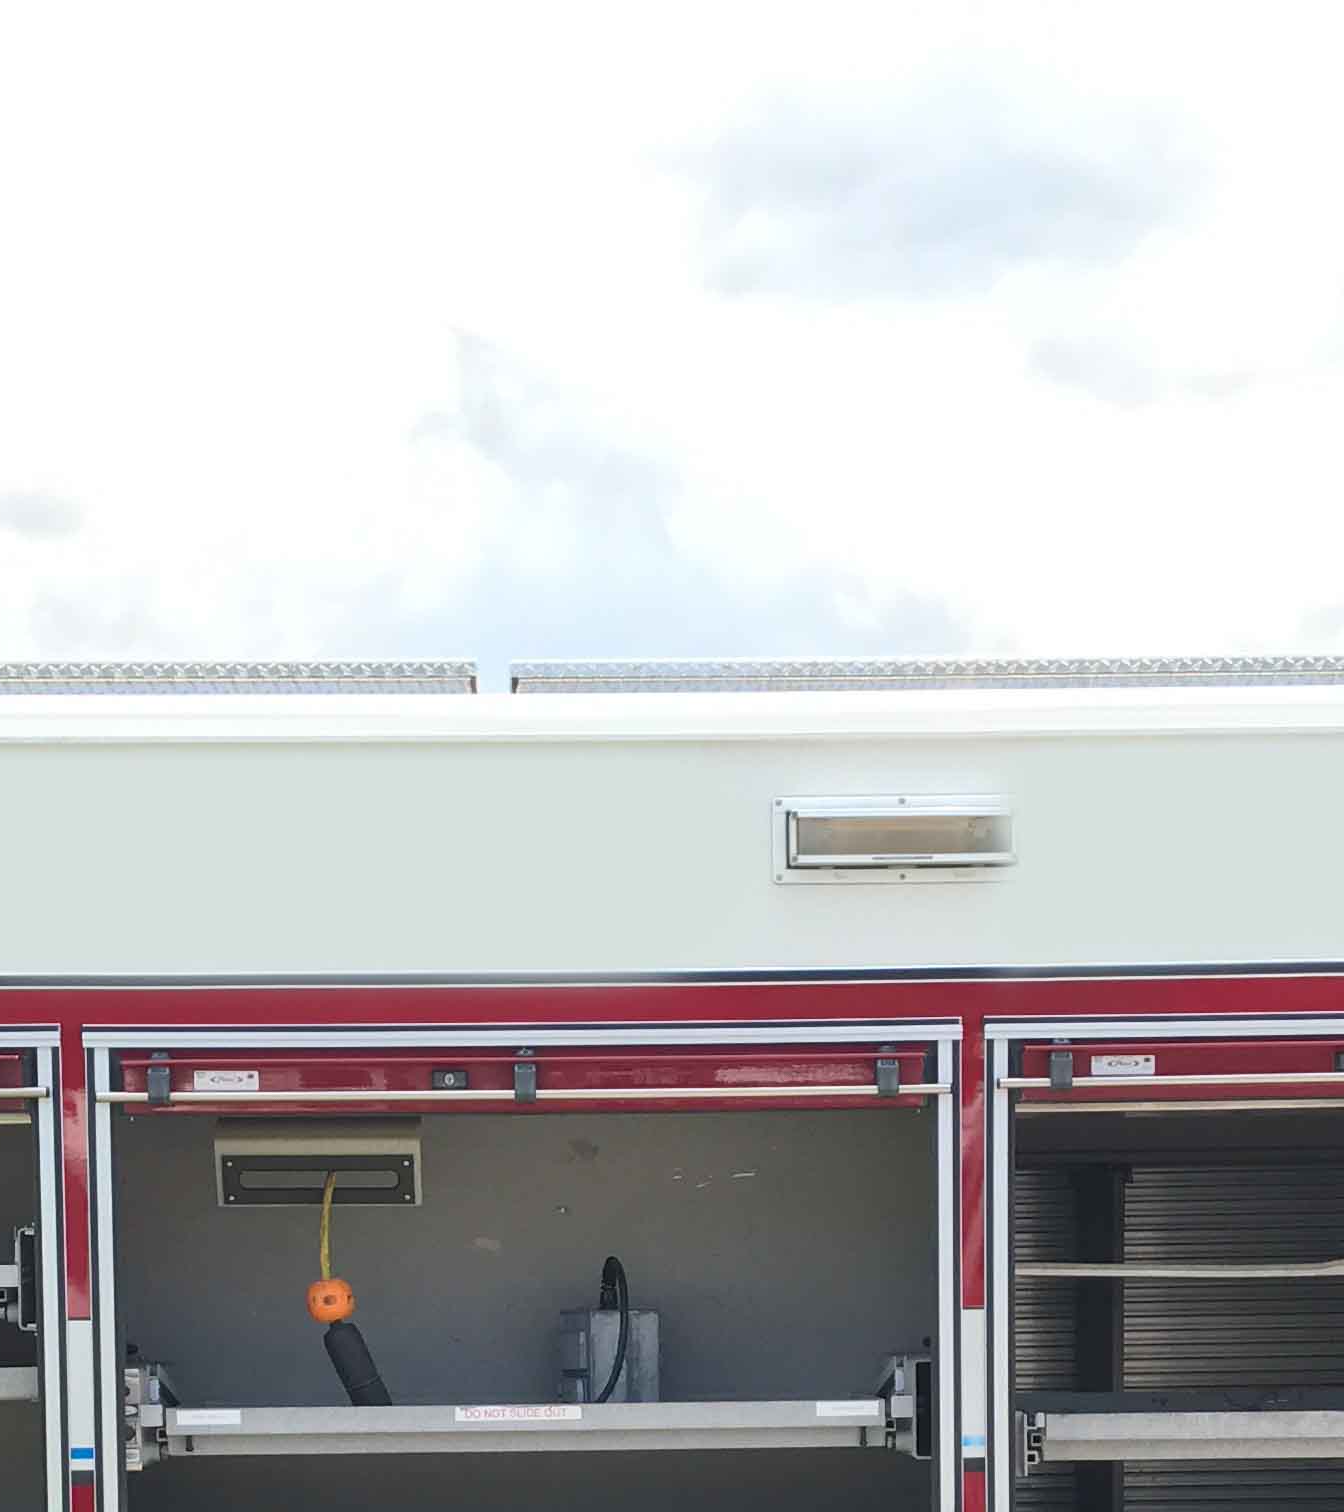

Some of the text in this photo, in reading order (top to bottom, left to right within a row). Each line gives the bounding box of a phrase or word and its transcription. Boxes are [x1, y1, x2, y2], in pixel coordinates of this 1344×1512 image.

[464, 1407, 567, 1418] DO NOT SLIDE OUT
